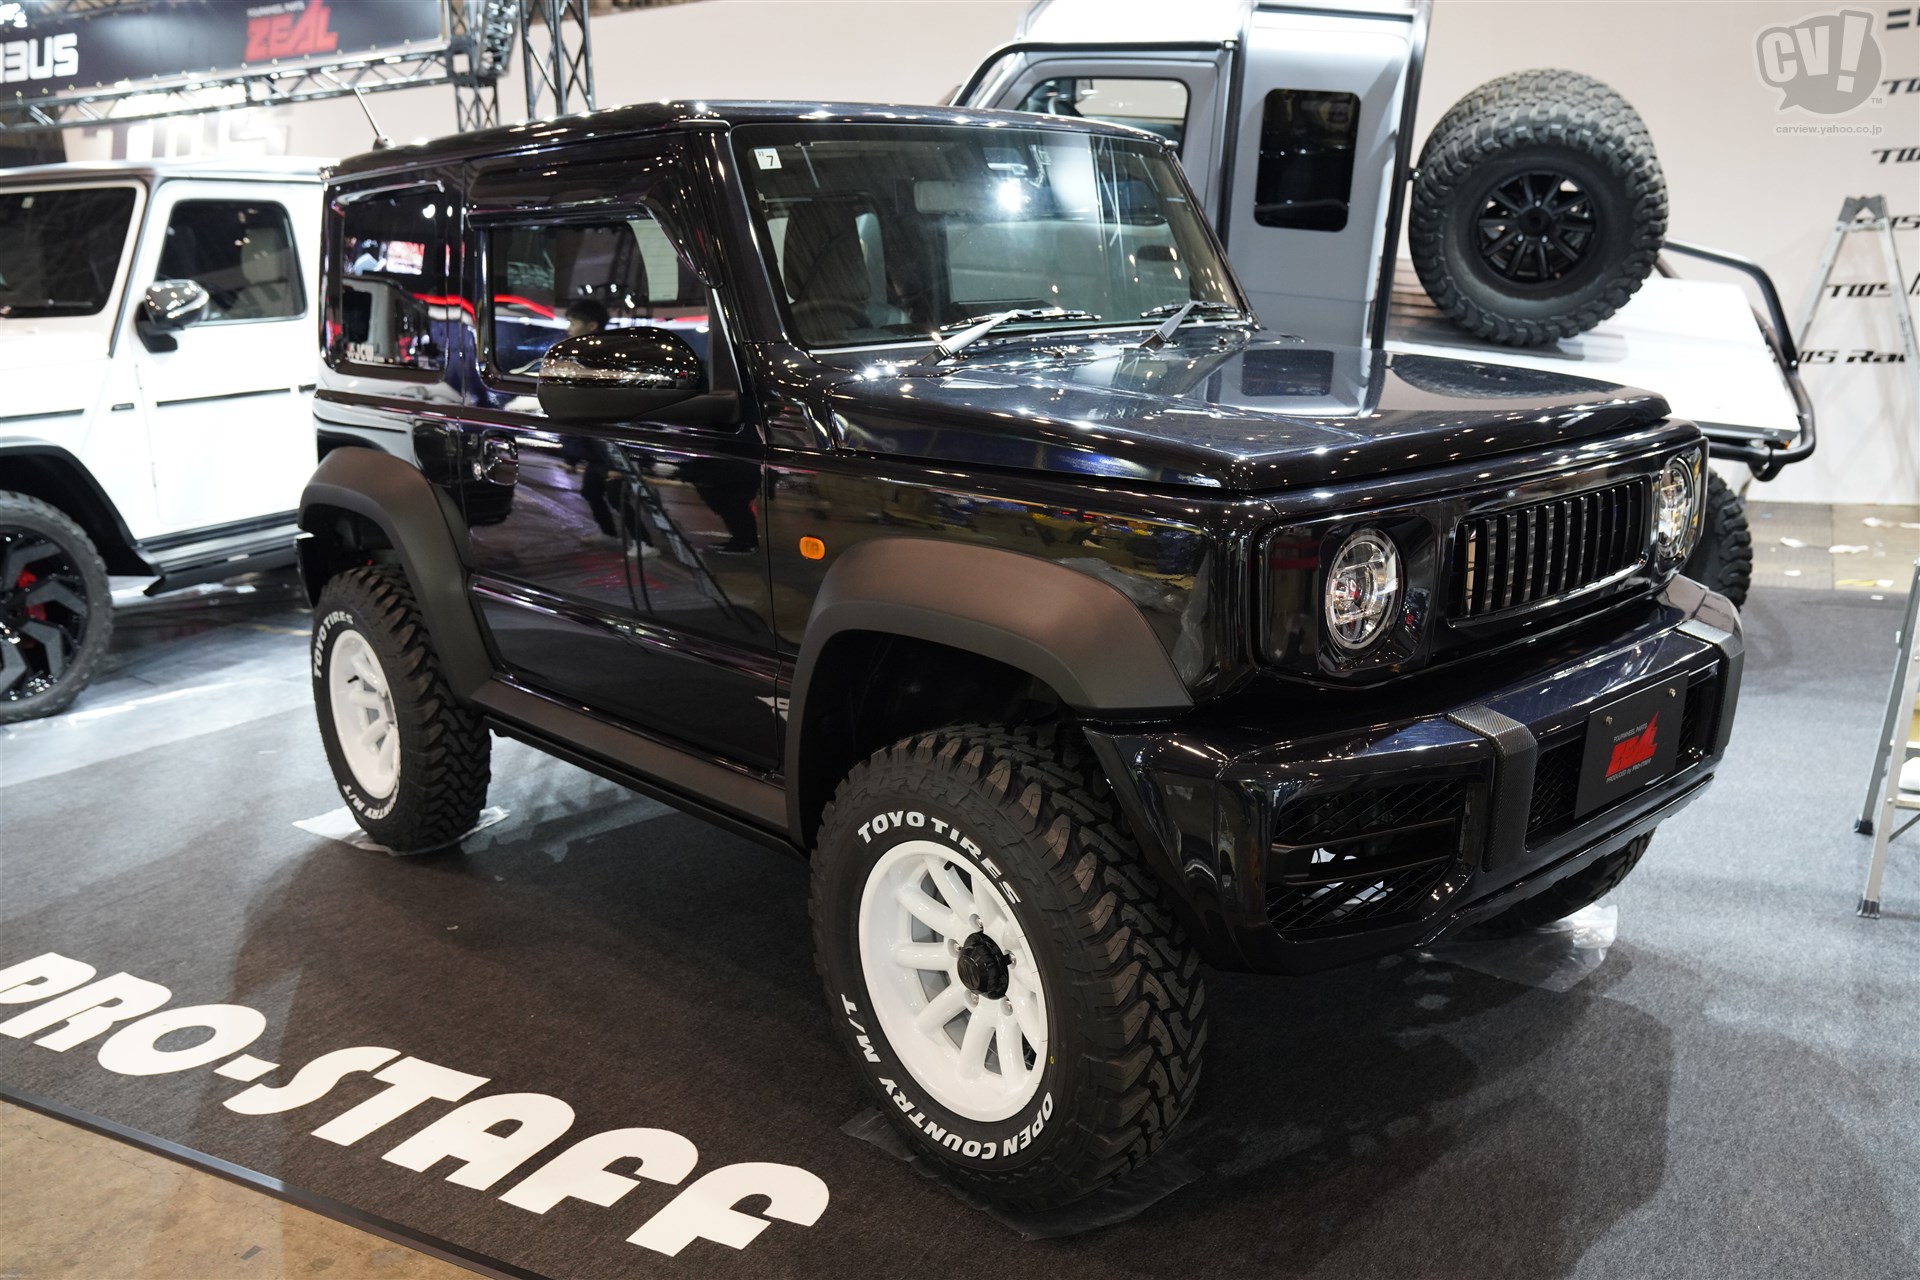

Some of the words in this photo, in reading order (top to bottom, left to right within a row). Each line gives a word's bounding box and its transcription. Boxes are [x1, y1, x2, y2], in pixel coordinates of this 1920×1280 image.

[244, 0, 339, 62] ZEAL
[766, 155, 774, 167] 7
[313, 625, 328, 679] TOYO
[323, 610, 354, 630] TIRES
[1605, 711, 1658, 777] ZEAL
[857, 810, 926, 844] TOYO
[930, 817, 1022, 905] TIRES
[841, 993, 881, 1064] M/T
[0, 951, 830, 1258] PRO-STAFF
[878, 1076, 997, 1160] COUNTRY
[1002, 1091, 1054, 1158] OPEN
